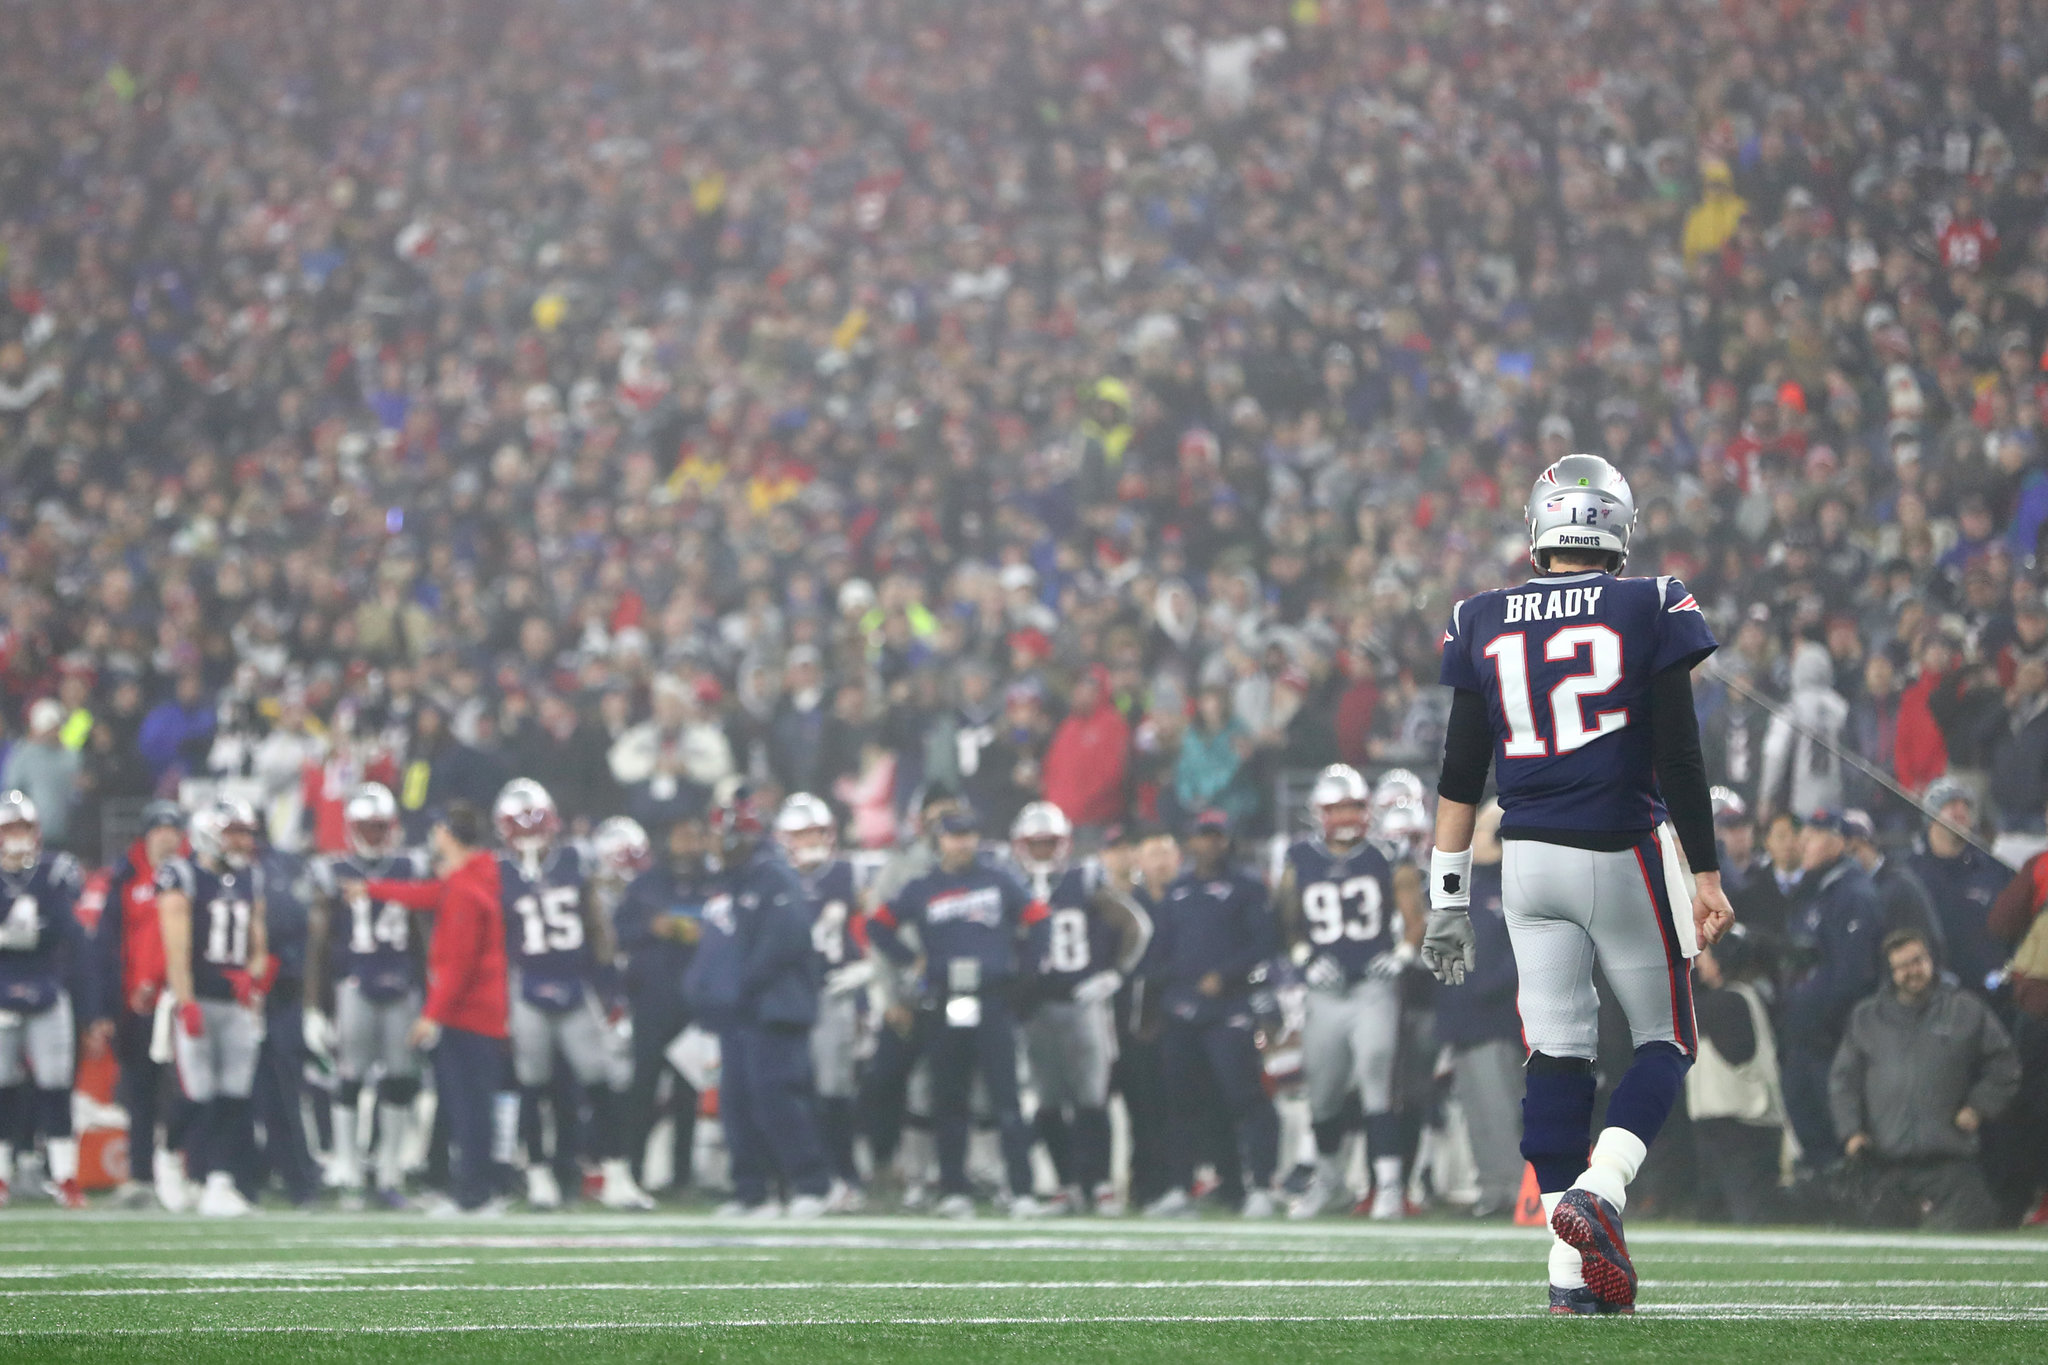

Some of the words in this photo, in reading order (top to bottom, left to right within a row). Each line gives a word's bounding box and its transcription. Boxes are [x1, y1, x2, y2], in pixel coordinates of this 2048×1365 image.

[1559, 535, 1600, 546] PATRIOTS
[1504, 587, 1603, 623] BRADY
[1483, 623, 1631, 759] 12
[205, 898, 251, 966] 11
[349, 897, 409, 953] 14
[513, 884, 584, 954] 15
[1303, 875, 1382, 944] 93
